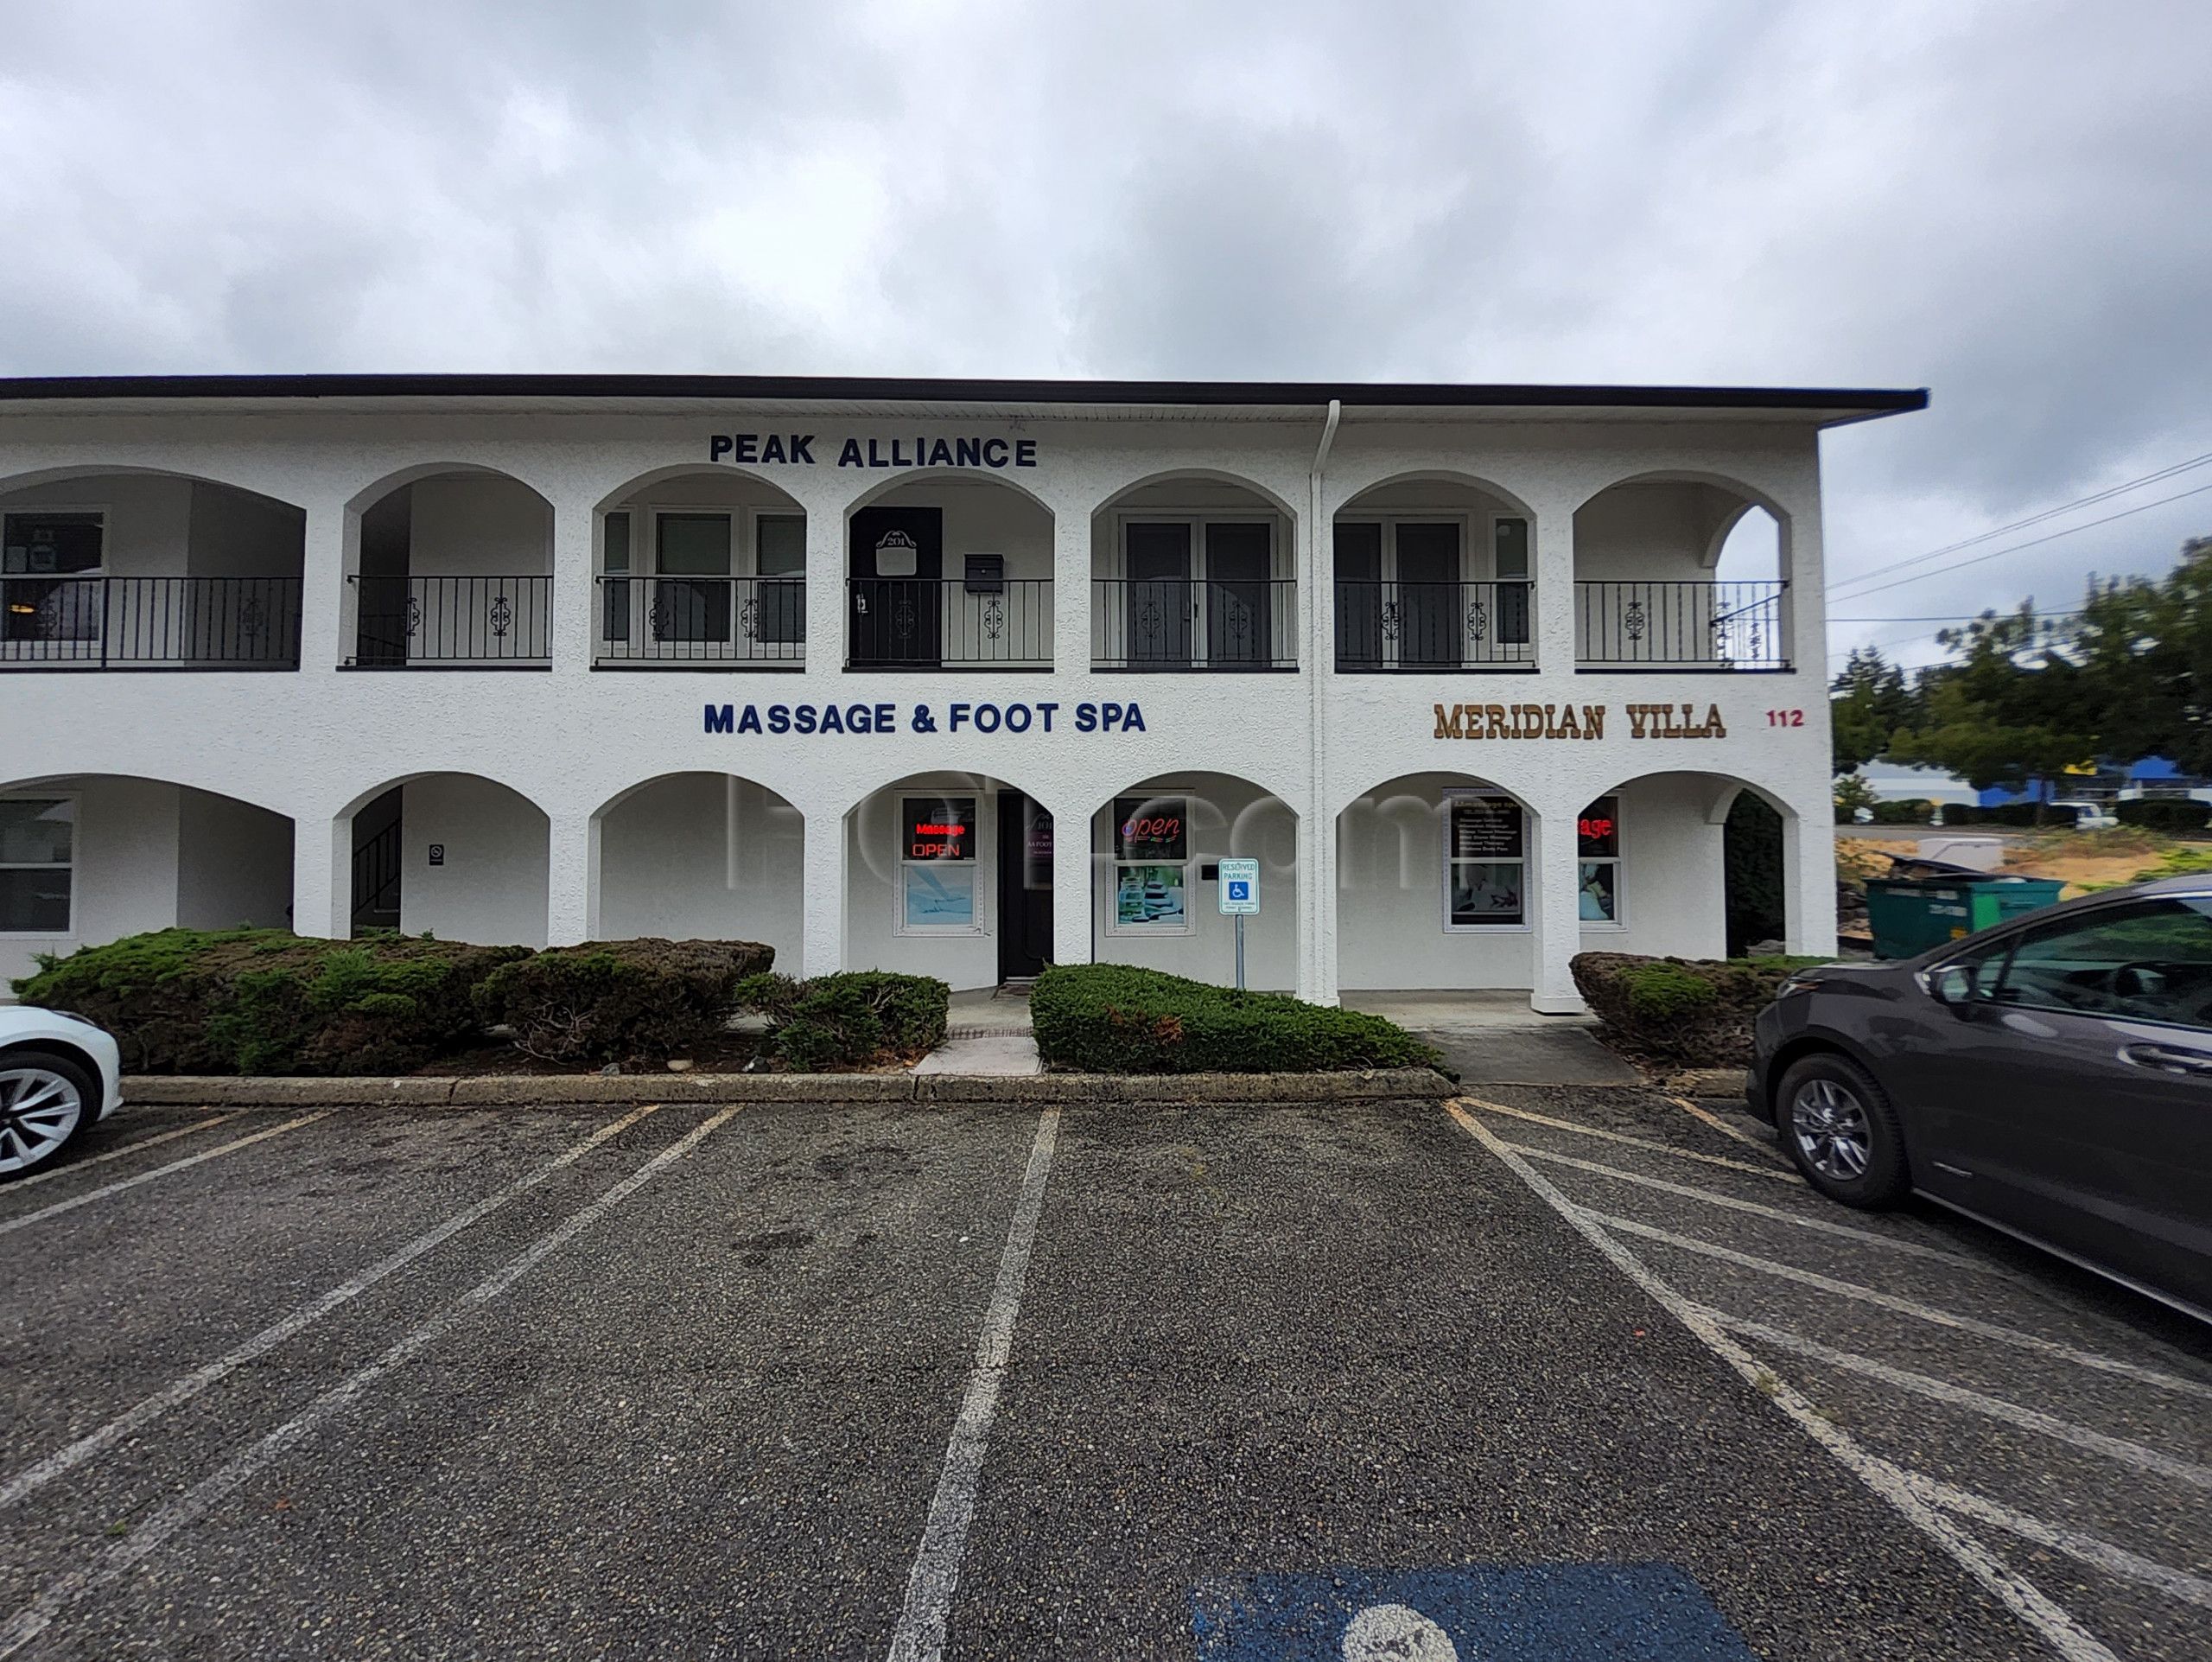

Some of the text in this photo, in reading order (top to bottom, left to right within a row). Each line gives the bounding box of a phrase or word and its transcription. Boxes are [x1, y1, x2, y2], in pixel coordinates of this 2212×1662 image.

[710, 434, 1038, 468] PEAK ALLIANCE
[887, 537, 906, 546] 201
[705, 704, 1146, 734] MASSAGE & FOOT SPA
[1434, 704, 1726, 739] MERIDIAN VILLA
[1766, 710, 1805, 727] 112
[912, 844, 961, 857] OPEN
